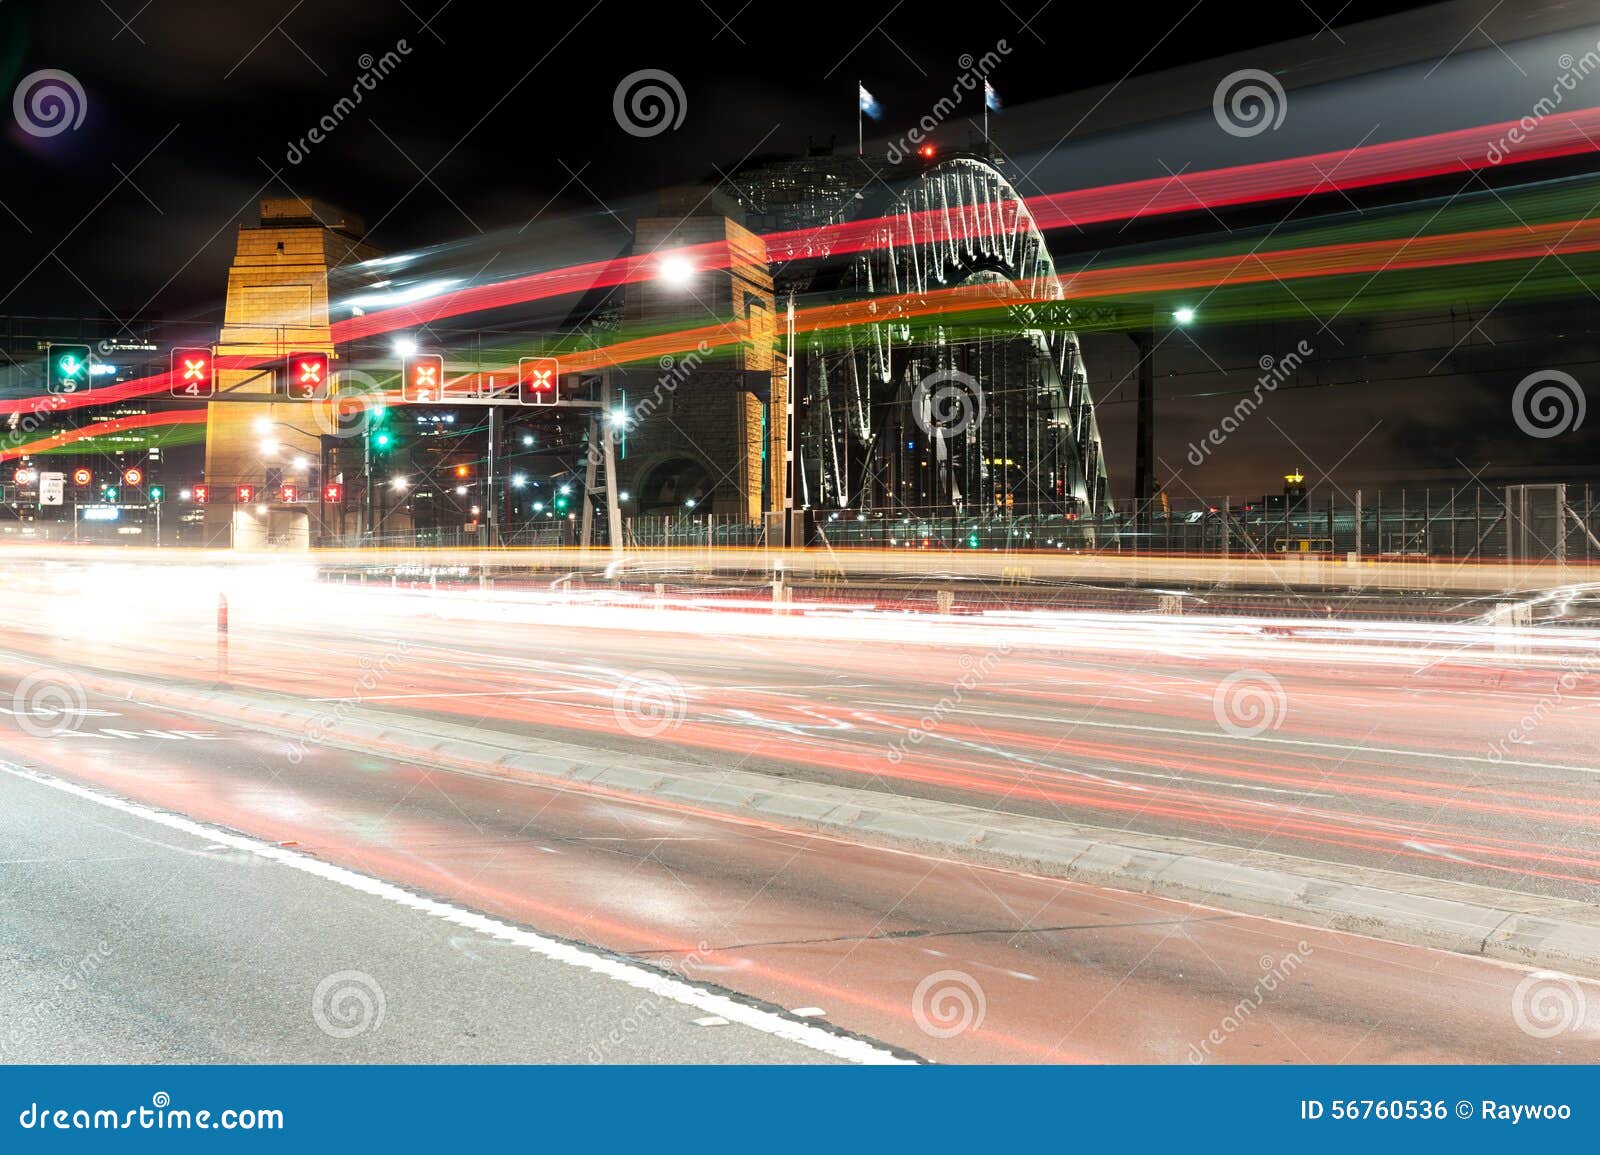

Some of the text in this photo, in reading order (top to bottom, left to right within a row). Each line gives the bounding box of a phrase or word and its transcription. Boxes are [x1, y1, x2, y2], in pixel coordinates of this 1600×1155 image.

[63, 378, 77, 393] 5
[184, 382, 200, 396] 4
[301, 384, 314, 398] 3
[416, 388, 430, 402] 2
[535, 390, 542, 404] 1
